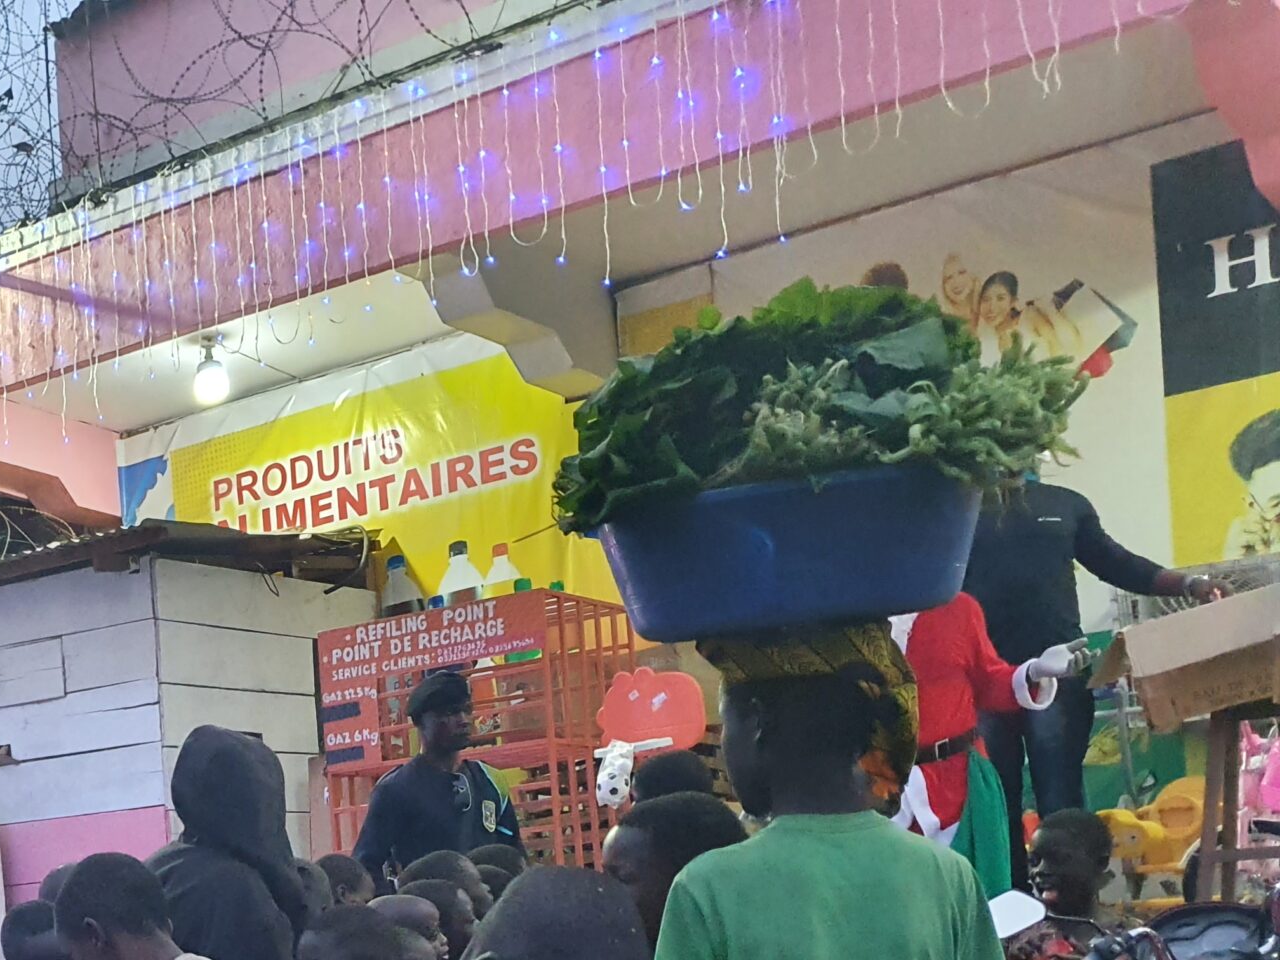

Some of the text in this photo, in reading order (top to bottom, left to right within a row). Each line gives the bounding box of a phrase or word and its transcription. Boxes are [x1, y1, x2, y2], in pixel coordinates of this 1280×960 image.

[213, 429, 404, 512] PRODUITS
[332, 640, 383, 665] POINT
[390, 635, 412, 655] DE
[418, 618, 505, 650] RECHARGE
[356, 600, 497, 643] REFILING POINT
[332, 661, 377, 681] SERVICE
[326, 731, 351, 746] GAZ
